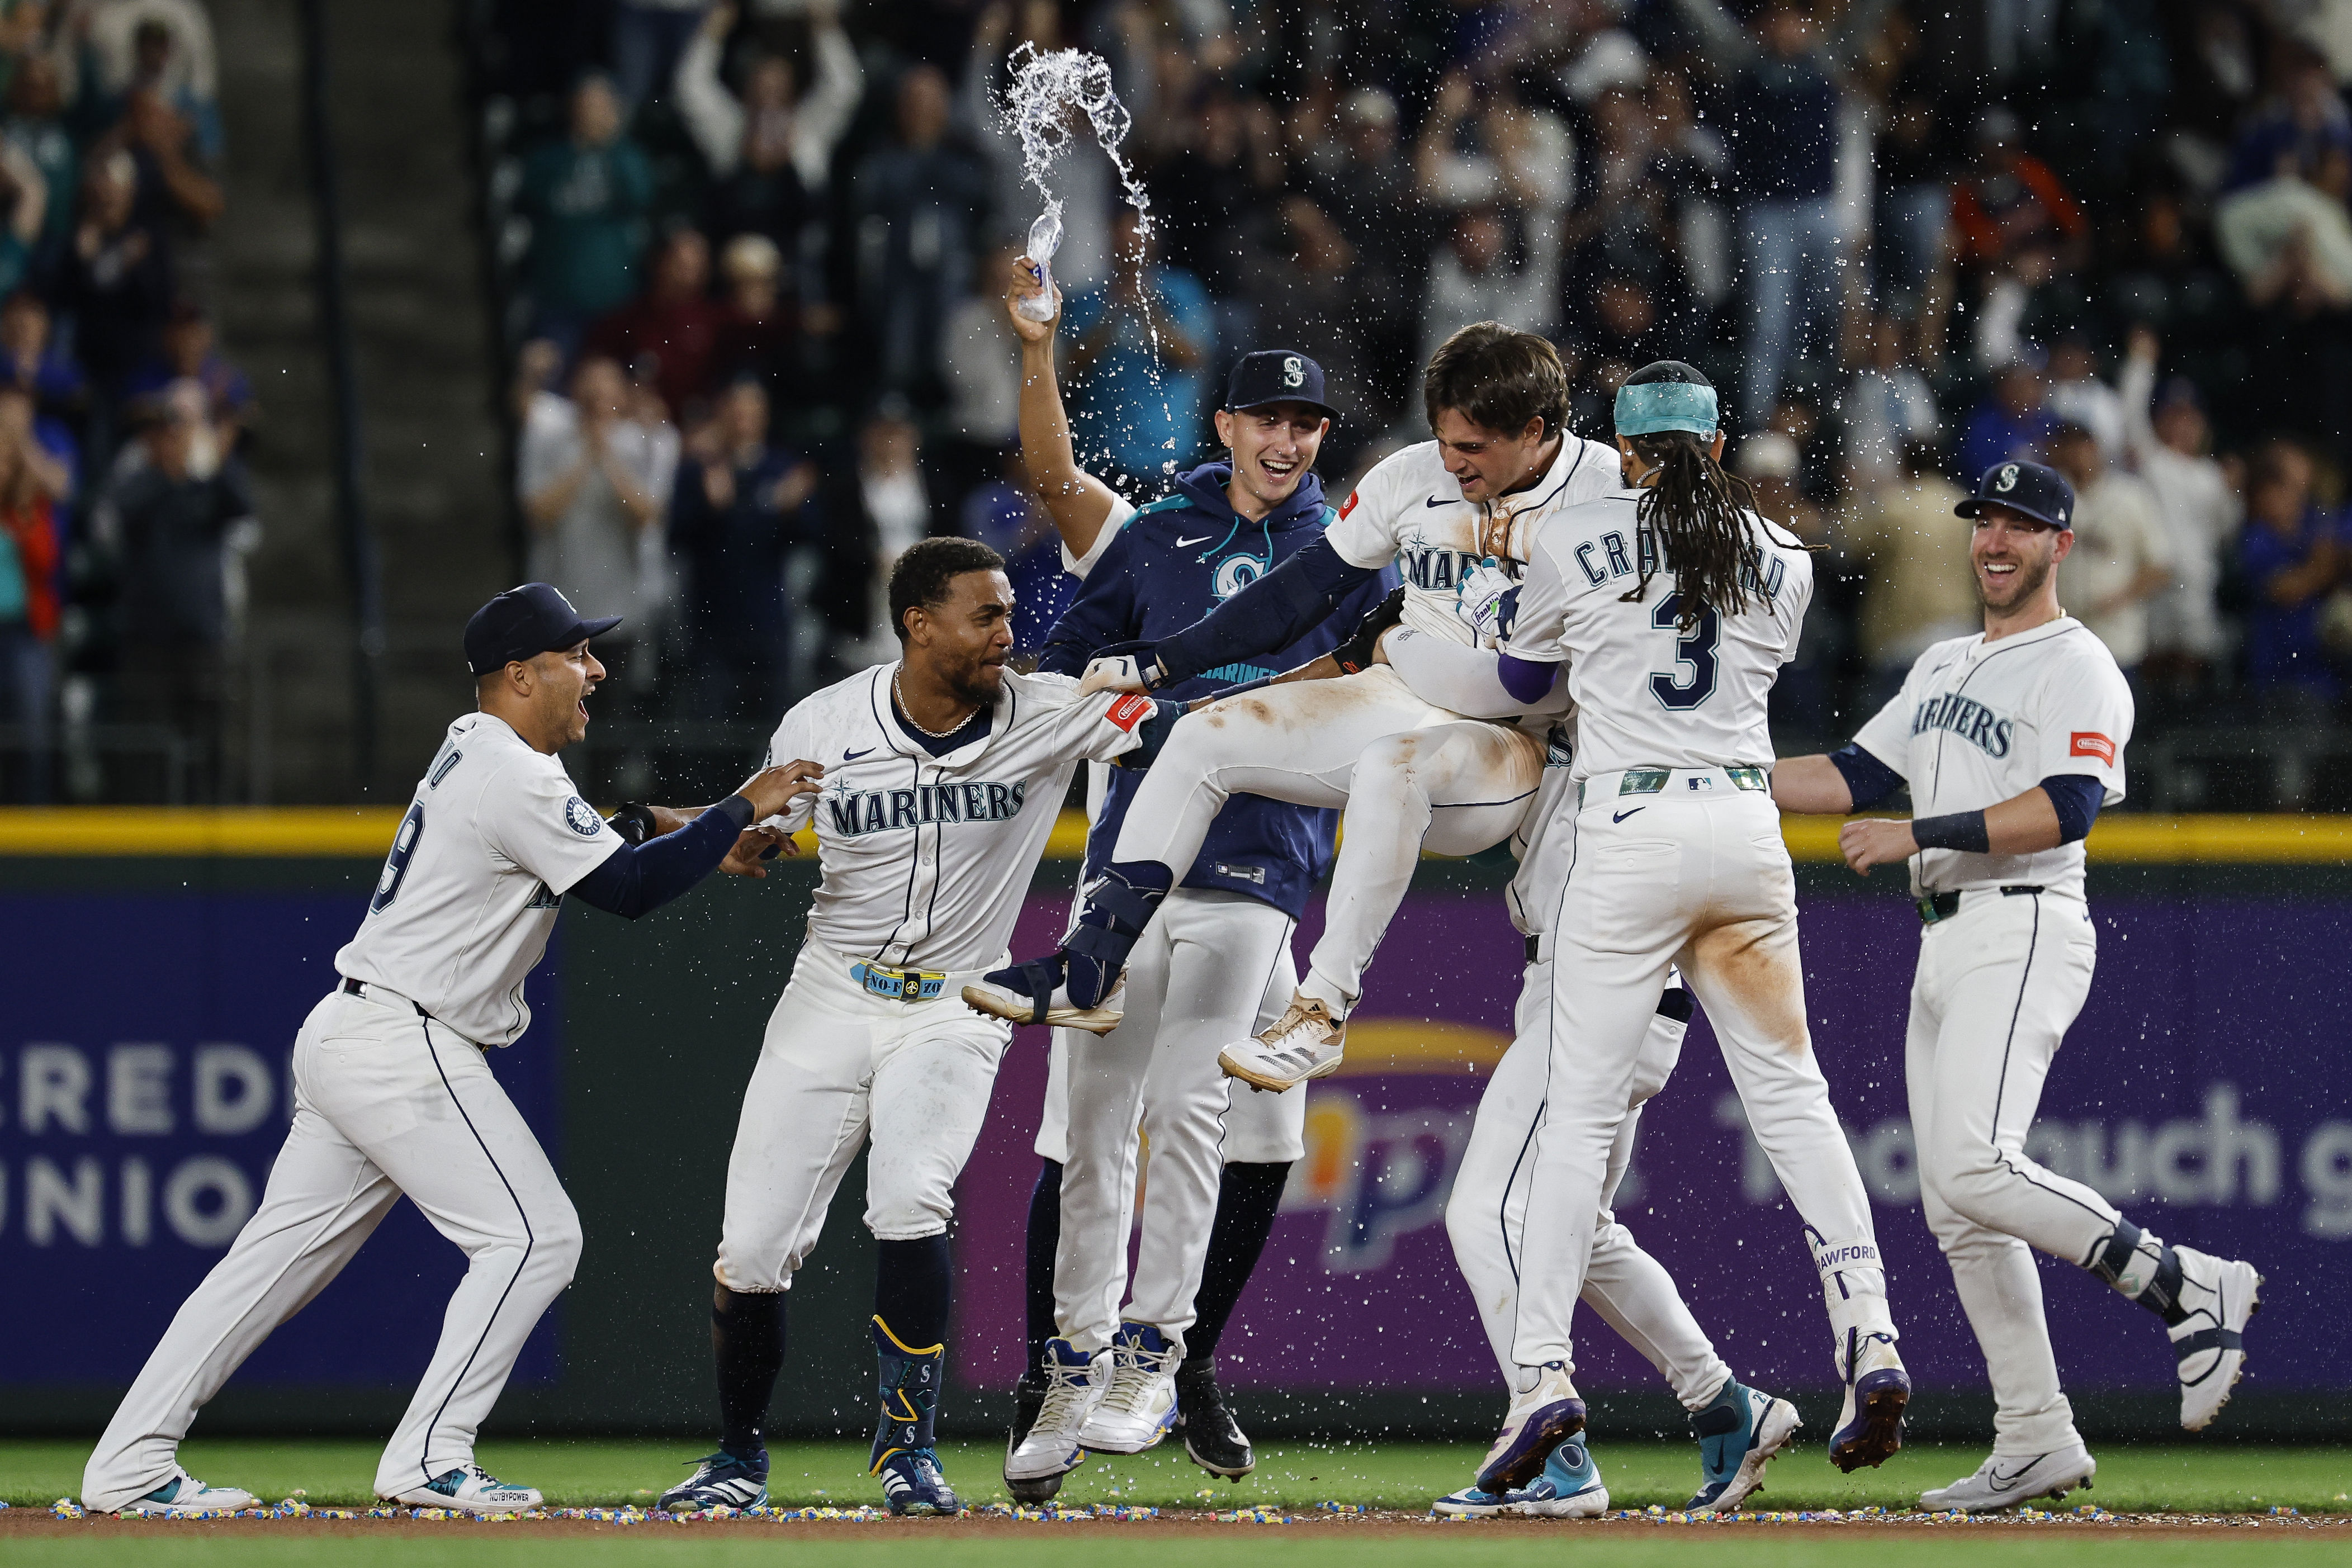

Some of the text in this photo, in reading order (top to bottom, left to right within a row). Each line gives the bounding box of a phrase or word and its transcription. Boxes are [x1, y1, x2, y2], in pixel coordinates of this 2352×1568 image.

[1649, 590, 1721, 712] 3
[826, 779, 1026, 837] MARINERS
[370, 799, 425, 916] 9
[923, 982, 944, 994] ZO
[489, 1492, 529, 1502] NOTBYPOWER
